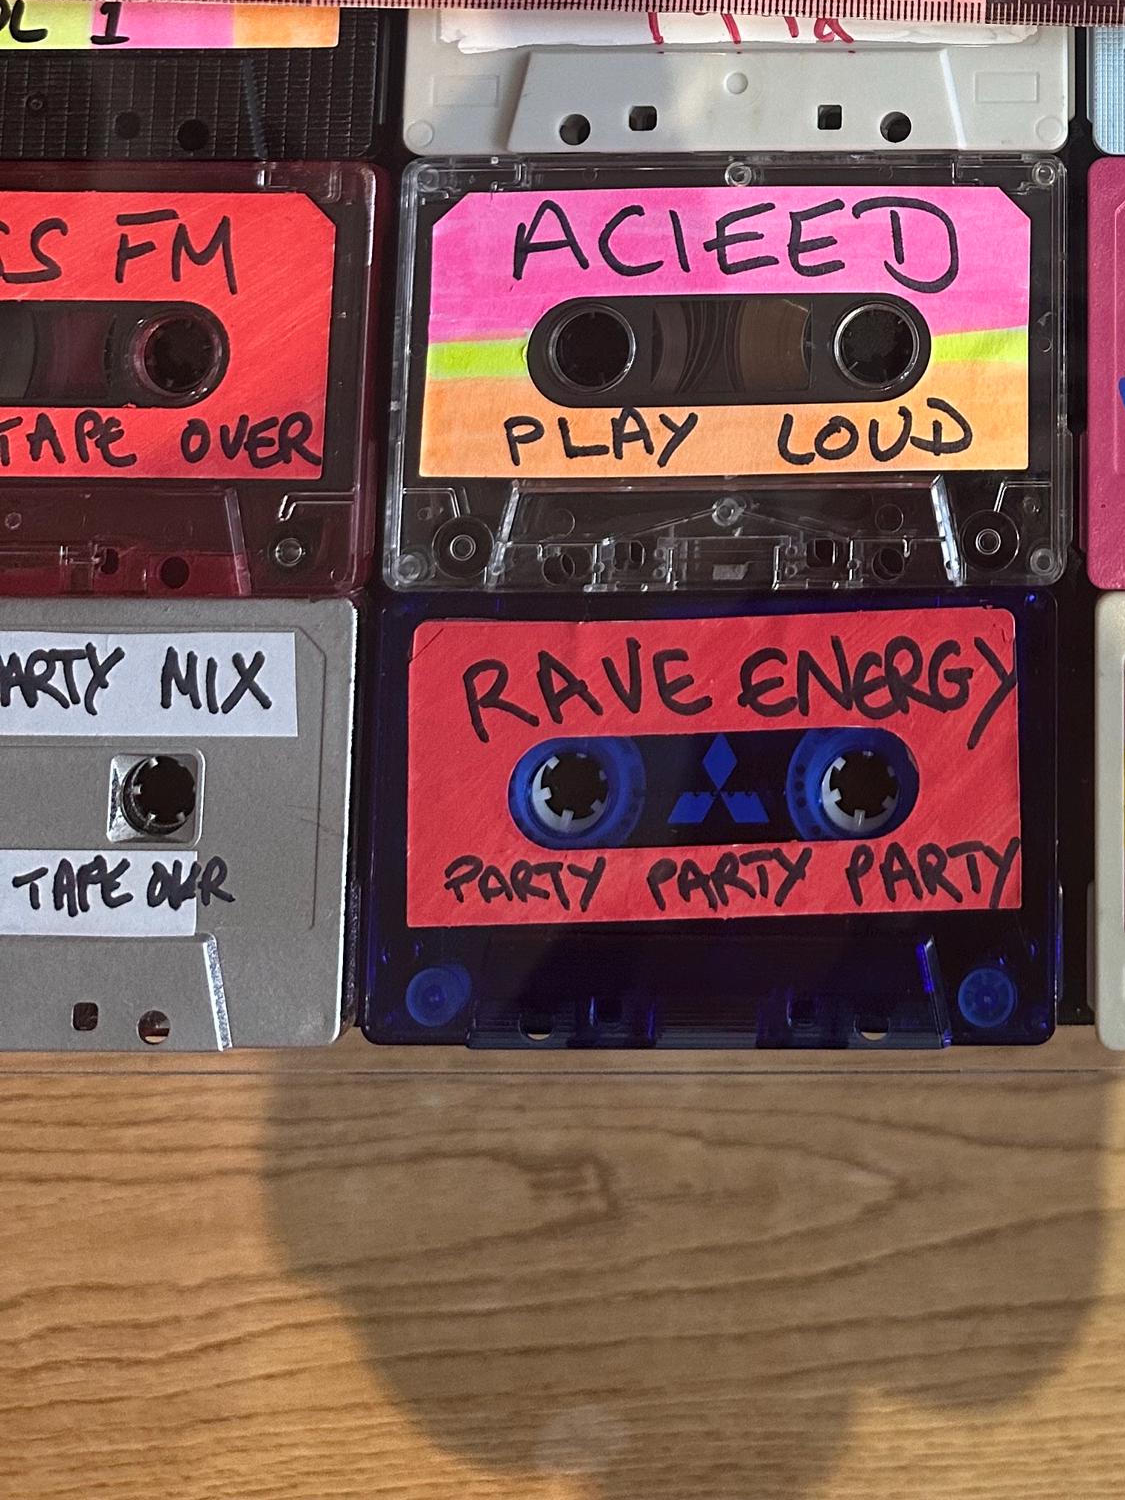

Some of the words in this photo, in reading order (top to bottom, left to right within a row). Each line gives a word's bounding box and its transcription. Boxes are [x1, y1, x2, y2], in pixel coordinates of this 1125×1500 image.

[90, 1, 130, 46] 1
[116, 209, 238, 295] FM
[513, 196, 958, 293] ACIEED
[0, 410, 137, 468] TAPE
[180, 411, 322, 469] OVER
[503, 406, 698, 467] PLAY
[777, 397, 974, 465] LOUD
[160, 646, 273, 715] MIX
[463, 636, 712, 743] RAVE
[737, 634, 1018, 750] ENERGY
[12, 855, 134, 917] TAPE
[444, 854, 607, 912] PARTY
[645, 847, 813, 911] PARTY
[845, 837, 1021, 910] PARTY
